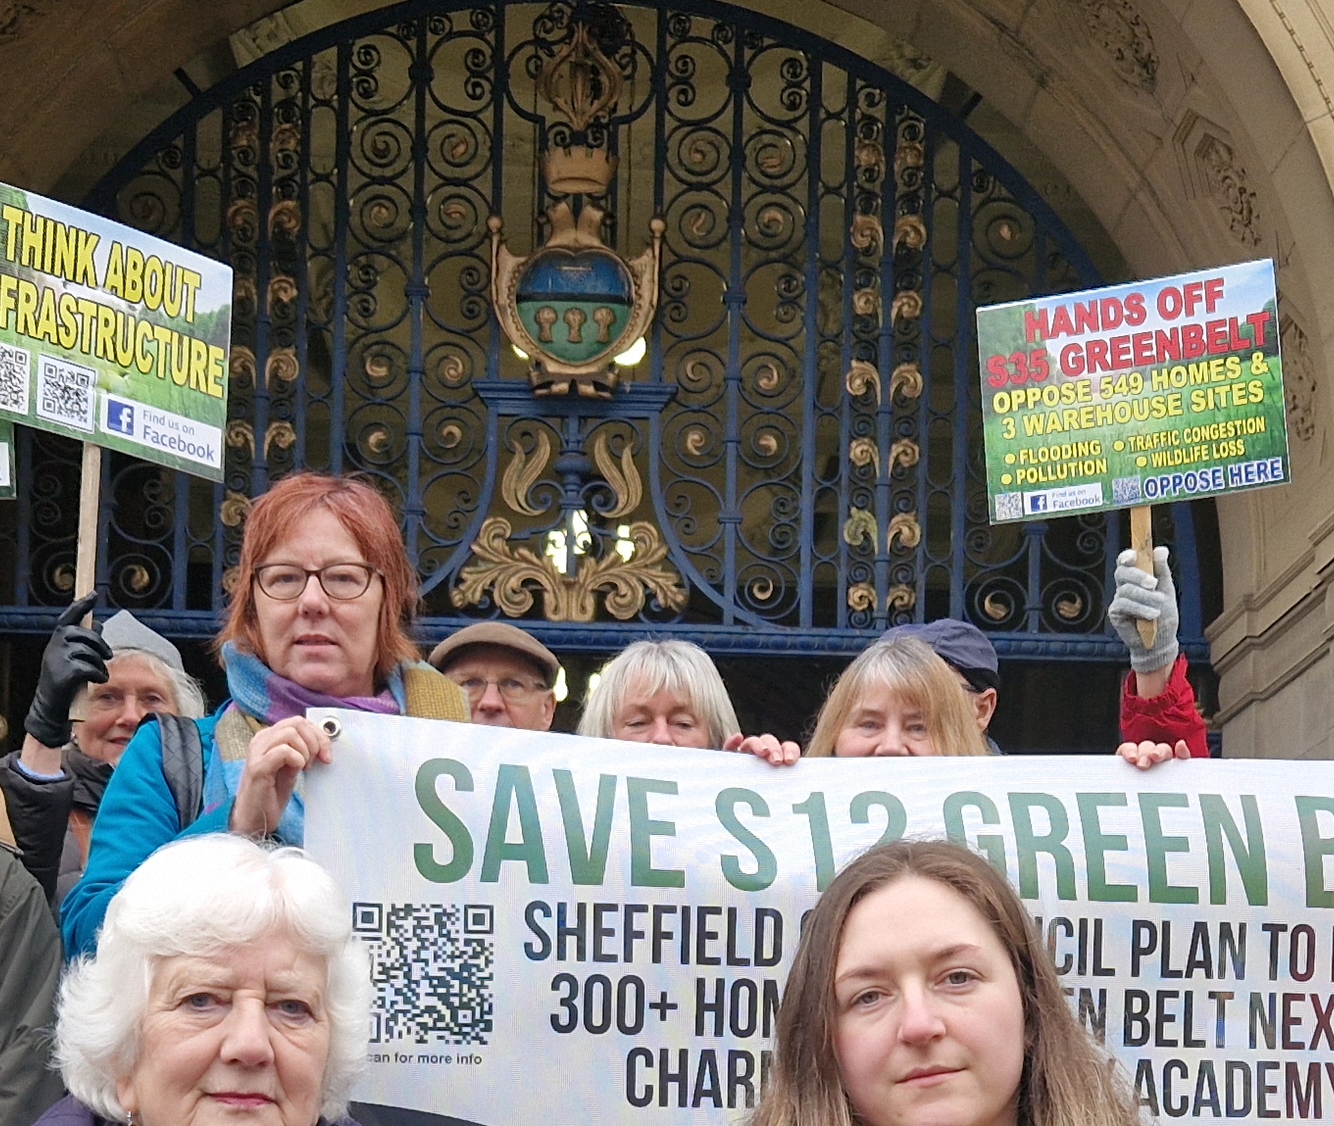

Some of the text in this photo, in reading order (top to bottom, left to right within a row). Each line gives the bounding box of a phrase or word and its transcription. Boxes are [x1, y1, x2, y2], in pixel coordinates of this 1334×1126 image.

[2, 205, 202, 323] THINK ABOUT
[1024, 278, 1224, 343] HANDS OFF
[986, 311, 1271, 388] S35 GREENBELT
[993, 351, 1269, 414] OPPOSE 549 HOMES &
[1002, 380, 1264, 440] 3 WAREHOUSE SITES
[143, 410, 195, 436] Find us on
[143, 425, 215, 462] Facebook
[1019, 439, 1101, 465] FLOODING
[1128, 416, 1266, 453] TRAFFIC CONGESTION
[1016, 458, 1107, 485] POLLUTION
[1144, 459, 1283, 499] OPPOSE HERE
[1151, 439, 1245, 469] WILDLIFE LOSS
[1052, 494, 1101, 510] Facebook
[413, 757, 685, 890] SAVE
[943, 791, 1269, 906] GREEN
[524, 899, 783, 967] SHEFFIELD
[1131, 920, 1246, 980] PLAN
[1262, 923, 1316, 982] TO
[550, 973, 678, 1036] 300+
[1123, 988, 1234, 1049] BELT
[367, 1052, 482, 1065] can for more info
[626, 1047, 772, 1108] CHAR
